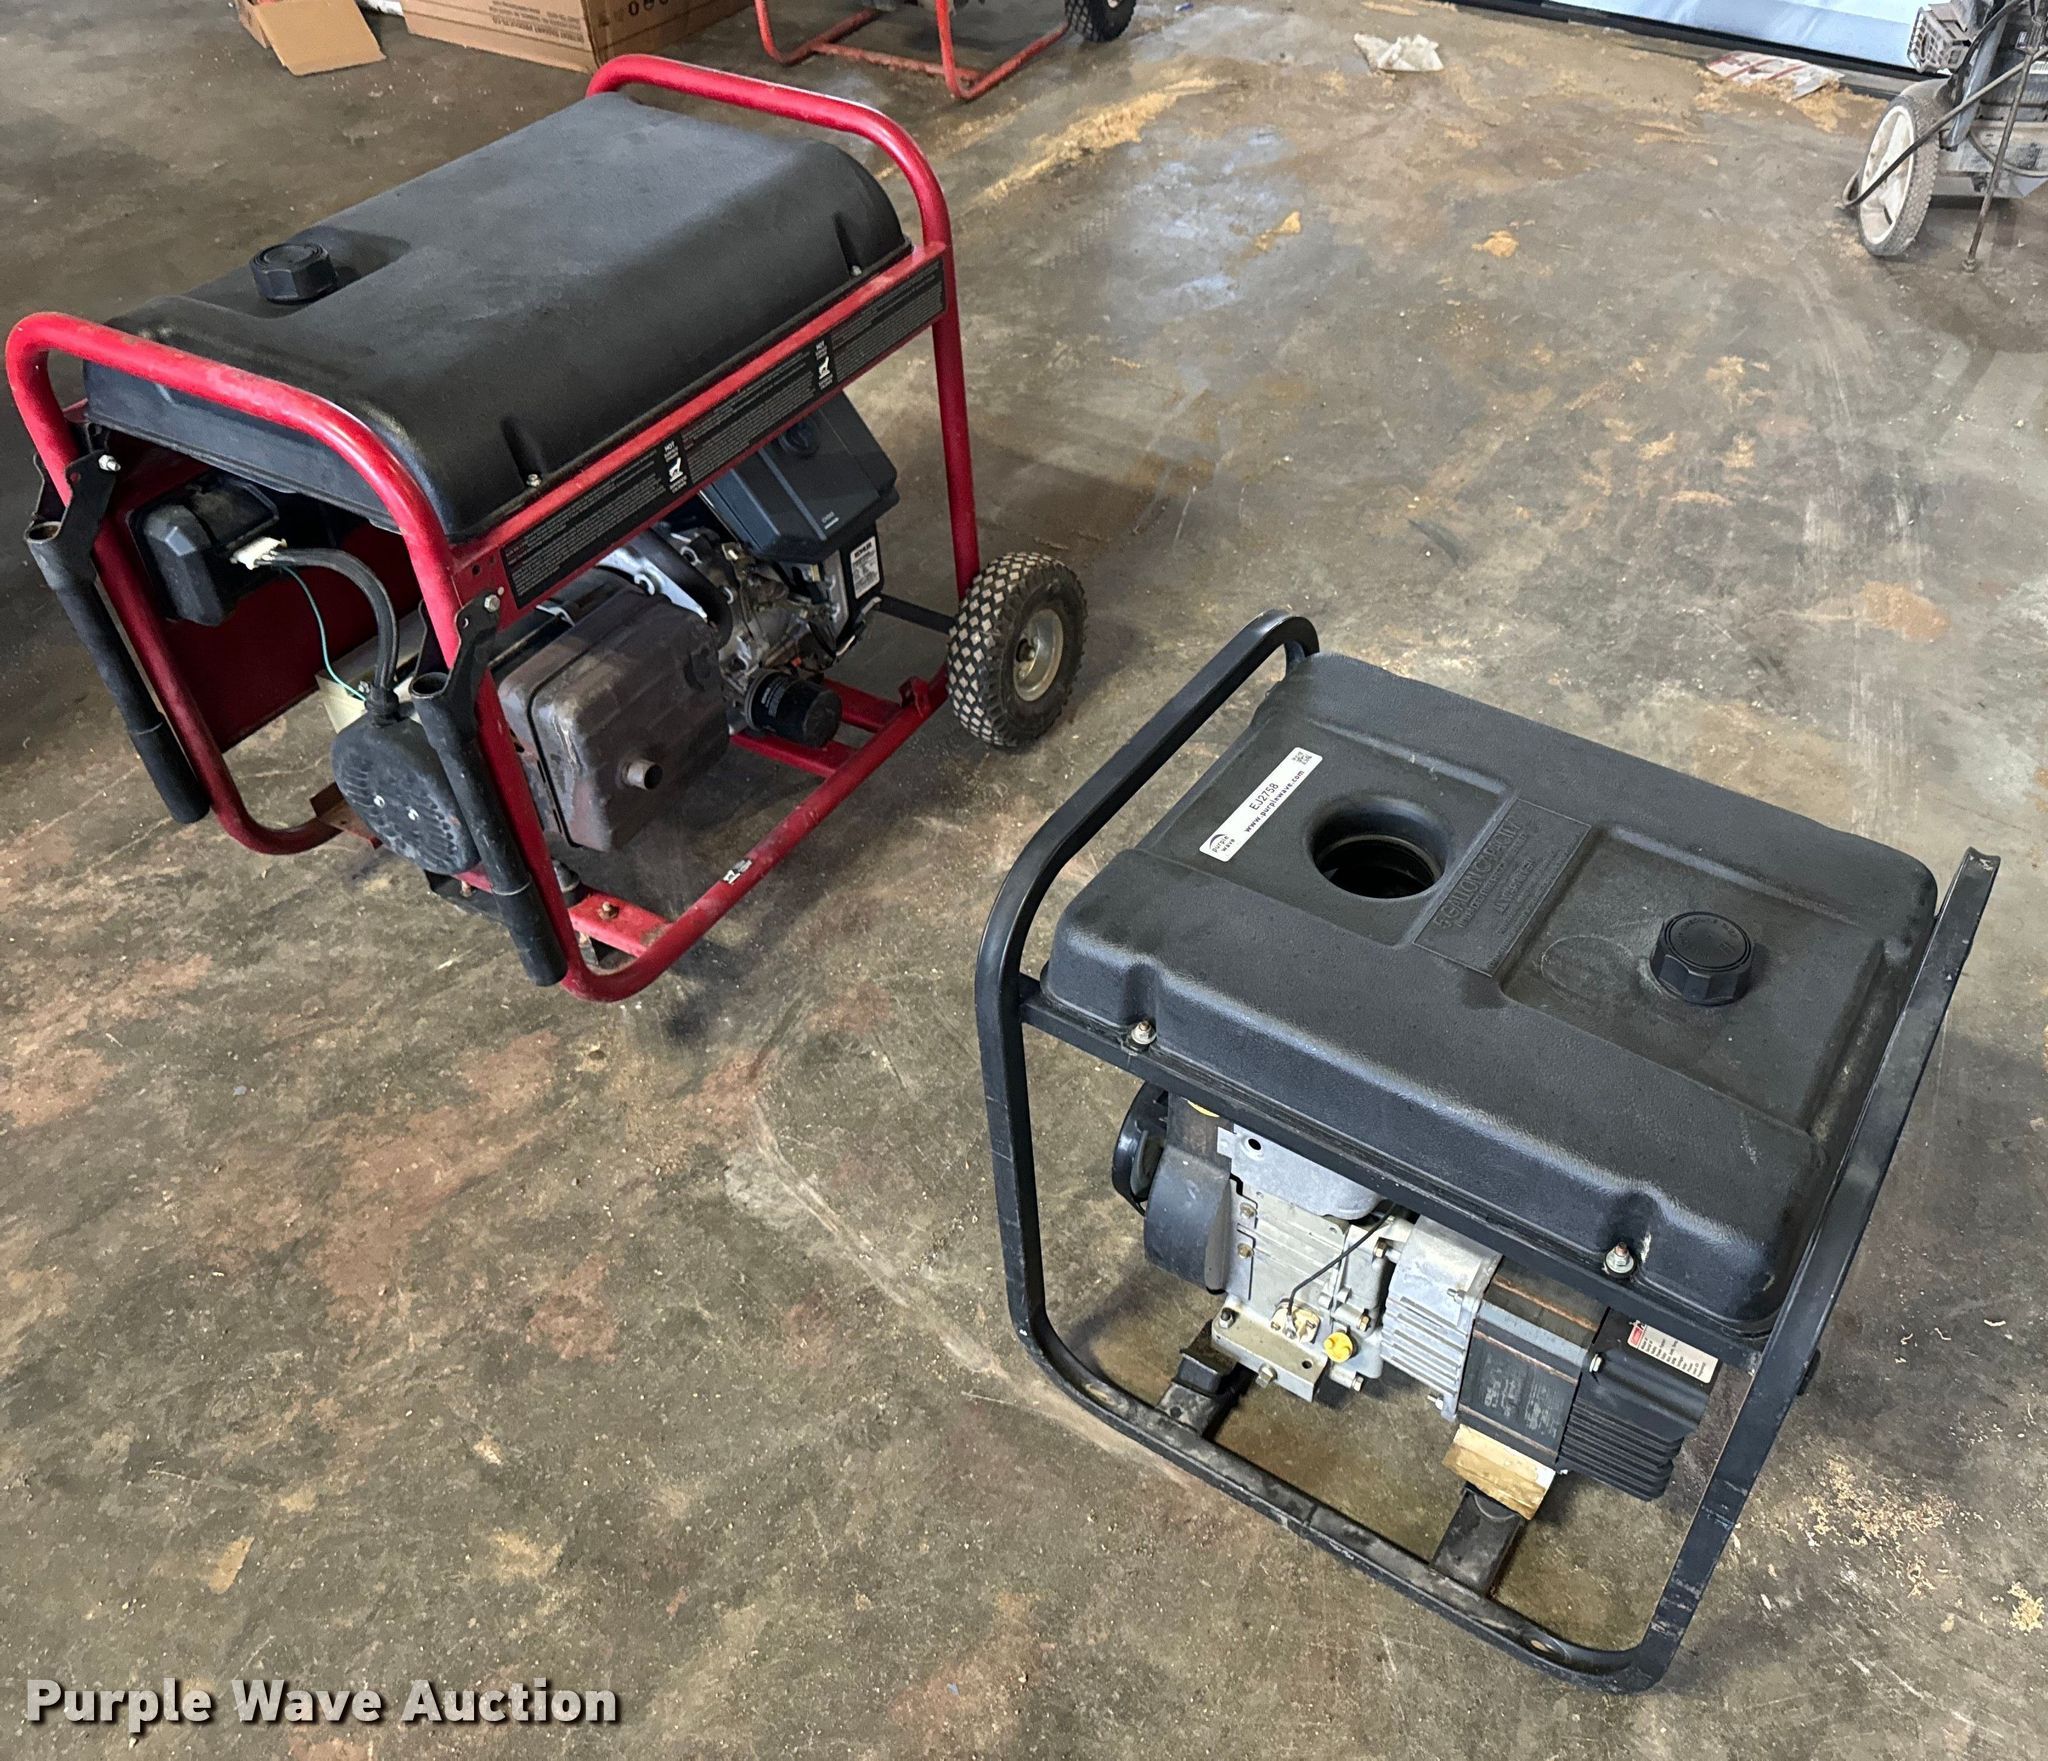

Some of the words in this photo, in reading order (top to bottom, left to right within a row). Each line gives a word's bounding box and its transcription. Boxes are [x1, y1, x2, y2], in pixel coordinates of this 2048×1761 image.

[1244, 770, 1305, 832] www.purplewave.com
[1249, 782, 1279, 811] EJ2758
[1211, 835, 1229, 853] purple
[1221, 838, 1235, 852] wave
